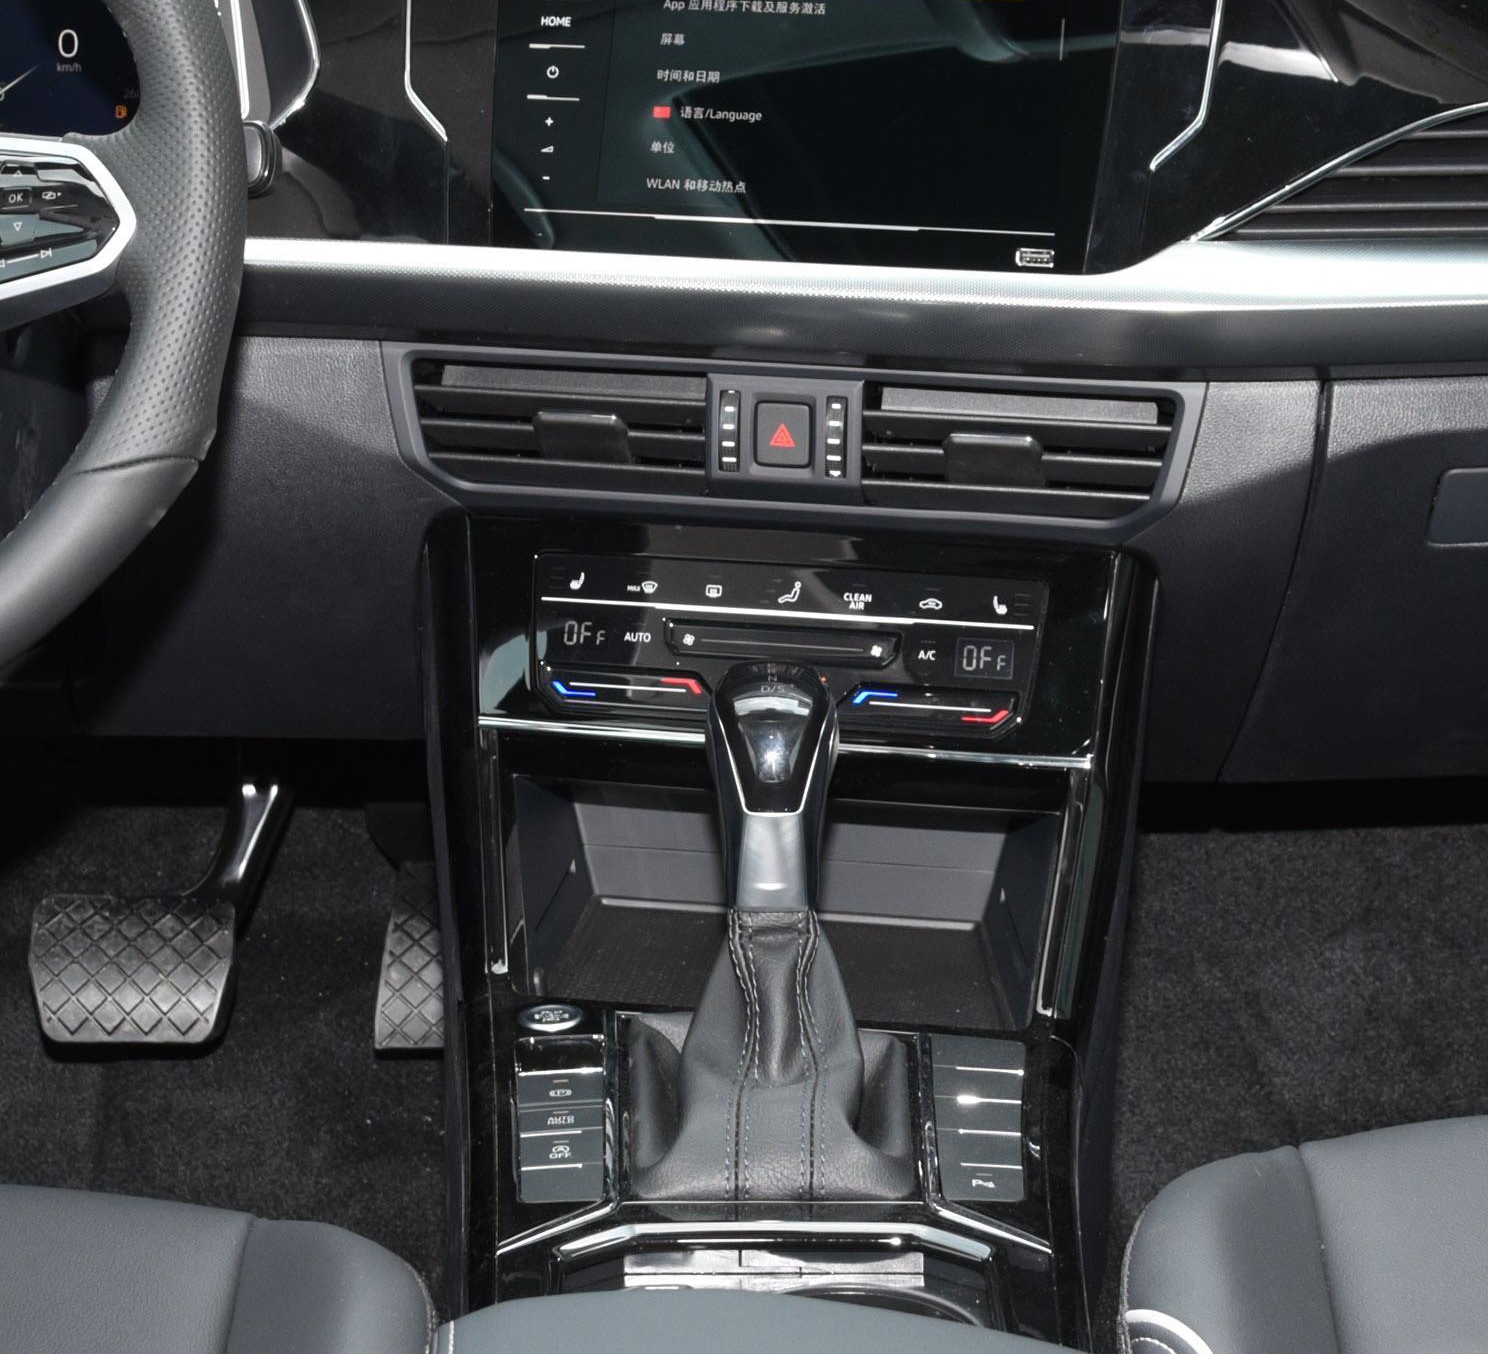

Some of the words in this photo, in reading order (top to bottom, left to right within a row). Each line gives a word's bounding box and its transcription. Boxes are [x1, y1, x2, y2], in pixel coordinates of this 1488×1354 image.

[540, 16, 572, 28] HOME
[58, 28, 79, 58] 0
[660, 32, 686, 46] 屏幕
[57, 62, 82, 72] km/h
[656, 68, 721, 84] 时间和日期
[679, 106, 763, 123] 语言/Language
[650, 140, 675, 154] 单位
[646, 177, 681, 191] WLAN
[683, 179, 747, 195] 和移动热点
[8, 194, 23, 203] OK
[843, 592, 872, 603] CLEAN
[849, 601, 865, 610] AIR
[624, 632, 651, 643] AUTO
[918, 650, 937, 661] A/C
